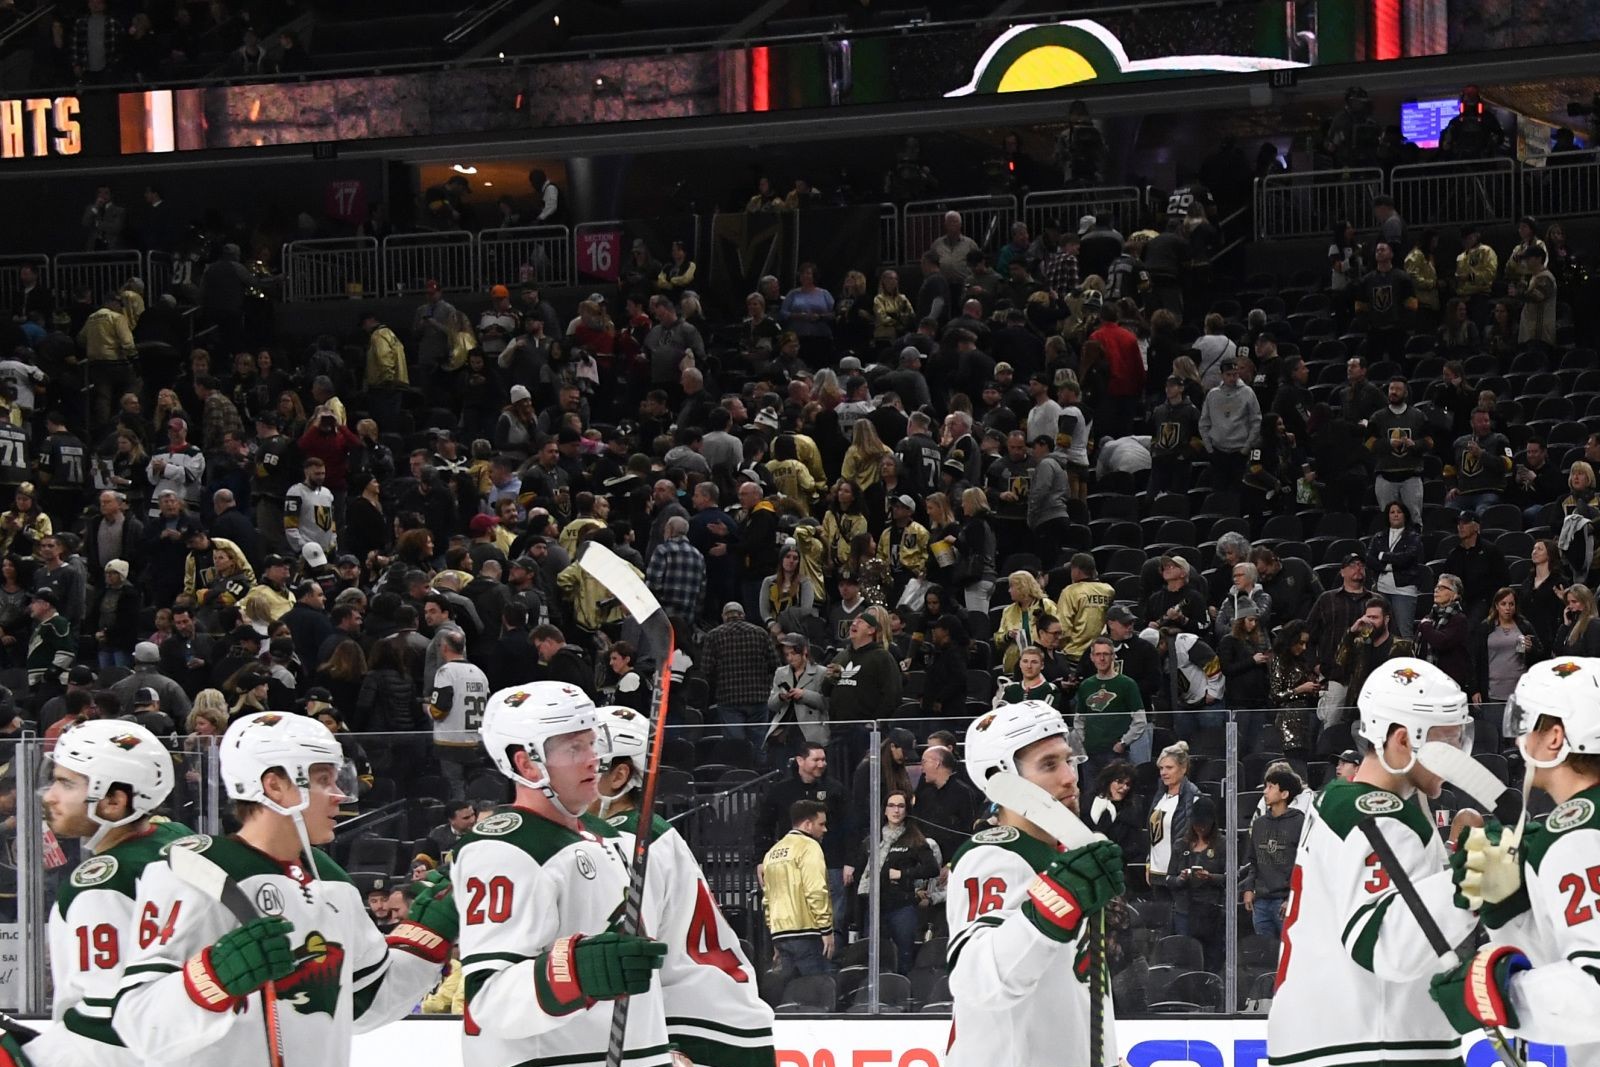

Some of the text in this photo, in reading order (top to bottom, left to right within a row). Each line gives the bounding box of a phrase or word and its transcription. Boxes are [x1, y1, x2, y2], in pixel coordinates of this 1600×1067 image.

[0, 96, 82, 158] HTS
[335, 187, 357, 215] 17
[584, 232, 615, 241] SECTION
[587, 240, 612, 272] 16
[465, 875, 515, 926] 20
[963, 877, 1009, 924] 16
[75, 923, 120, 972] 19
[138, 900, 183, 951] 64
